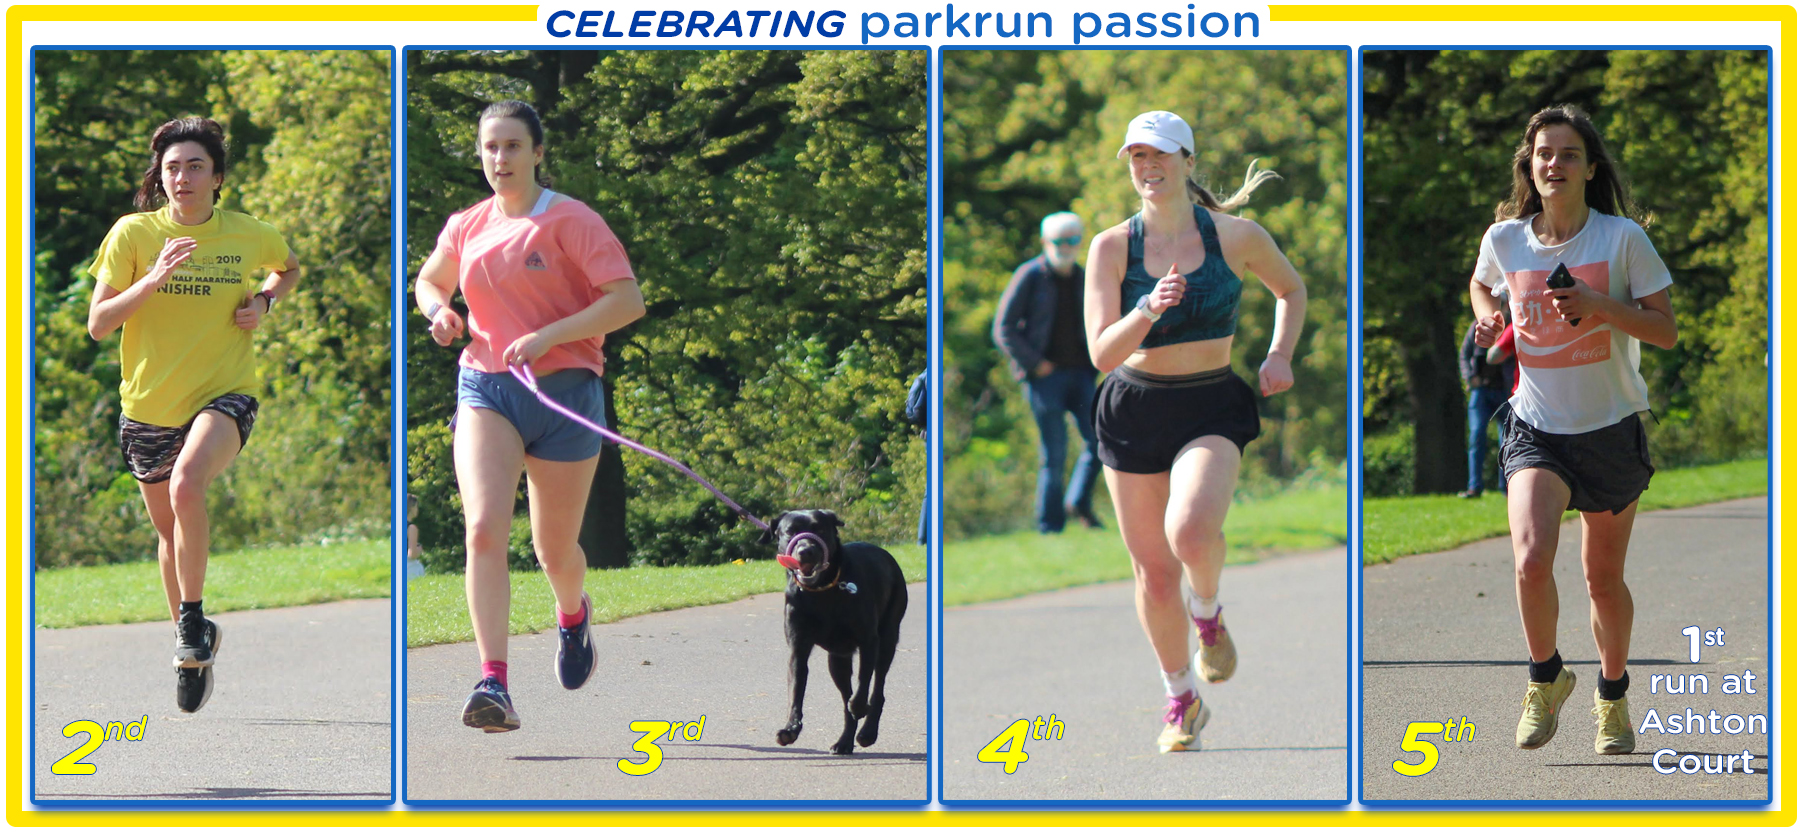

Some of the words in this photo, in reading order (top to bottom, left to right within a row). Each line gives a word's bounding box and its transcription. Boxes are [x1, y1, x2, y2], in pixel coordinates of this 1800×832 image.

[216, 255, 242, 264] 2019
[195, 276, 242, 284] MARATHON
[157, 283, 211, 296] NISHER
